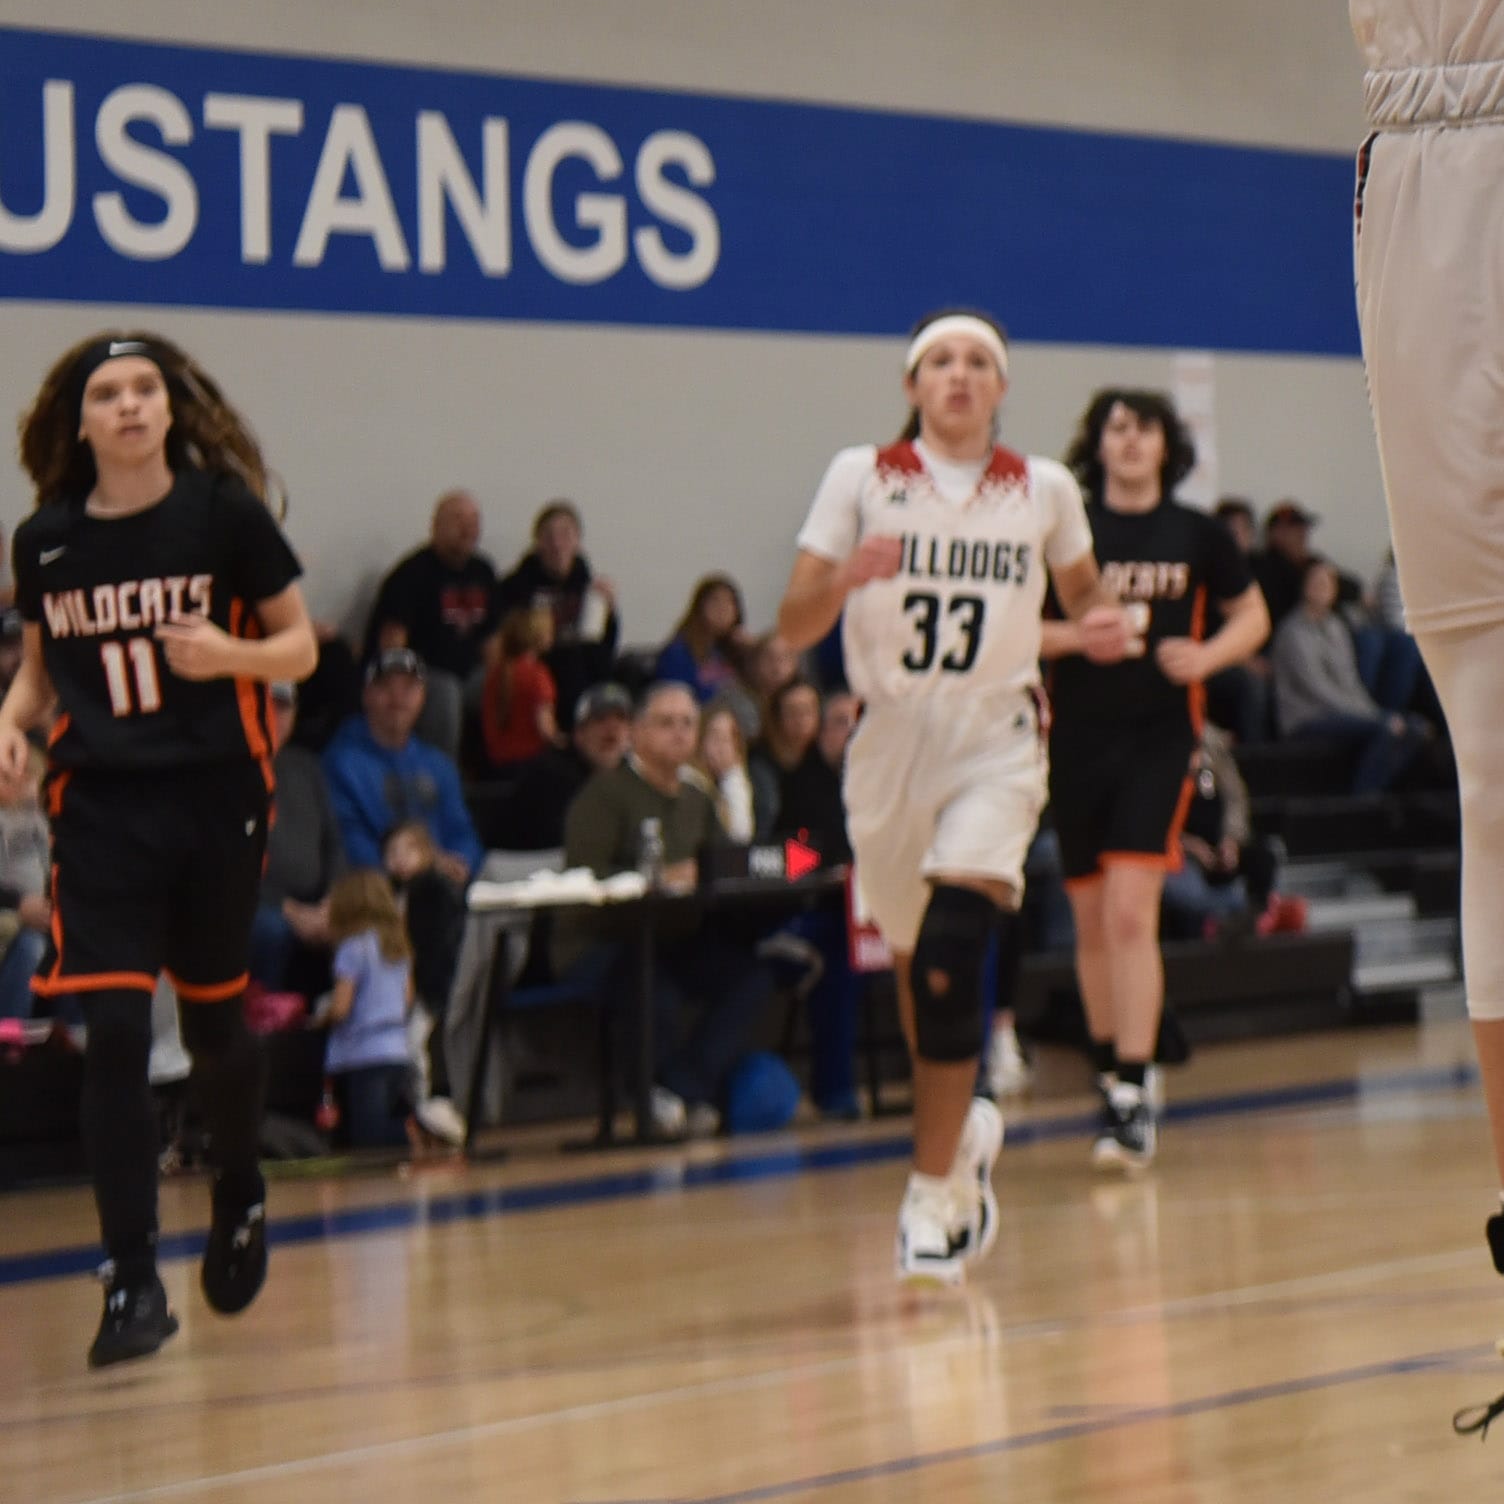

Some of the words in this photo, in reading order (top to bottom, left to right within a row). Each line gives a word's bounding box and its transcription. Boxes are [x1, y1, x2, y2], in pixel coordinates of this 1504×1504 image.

[899, 532, 1030, 586] LLDOGS
[43, 573, 213, 640] WILDCATS
[902, 592, 985, 674] 33
[101, 637, 162, 718] 11
